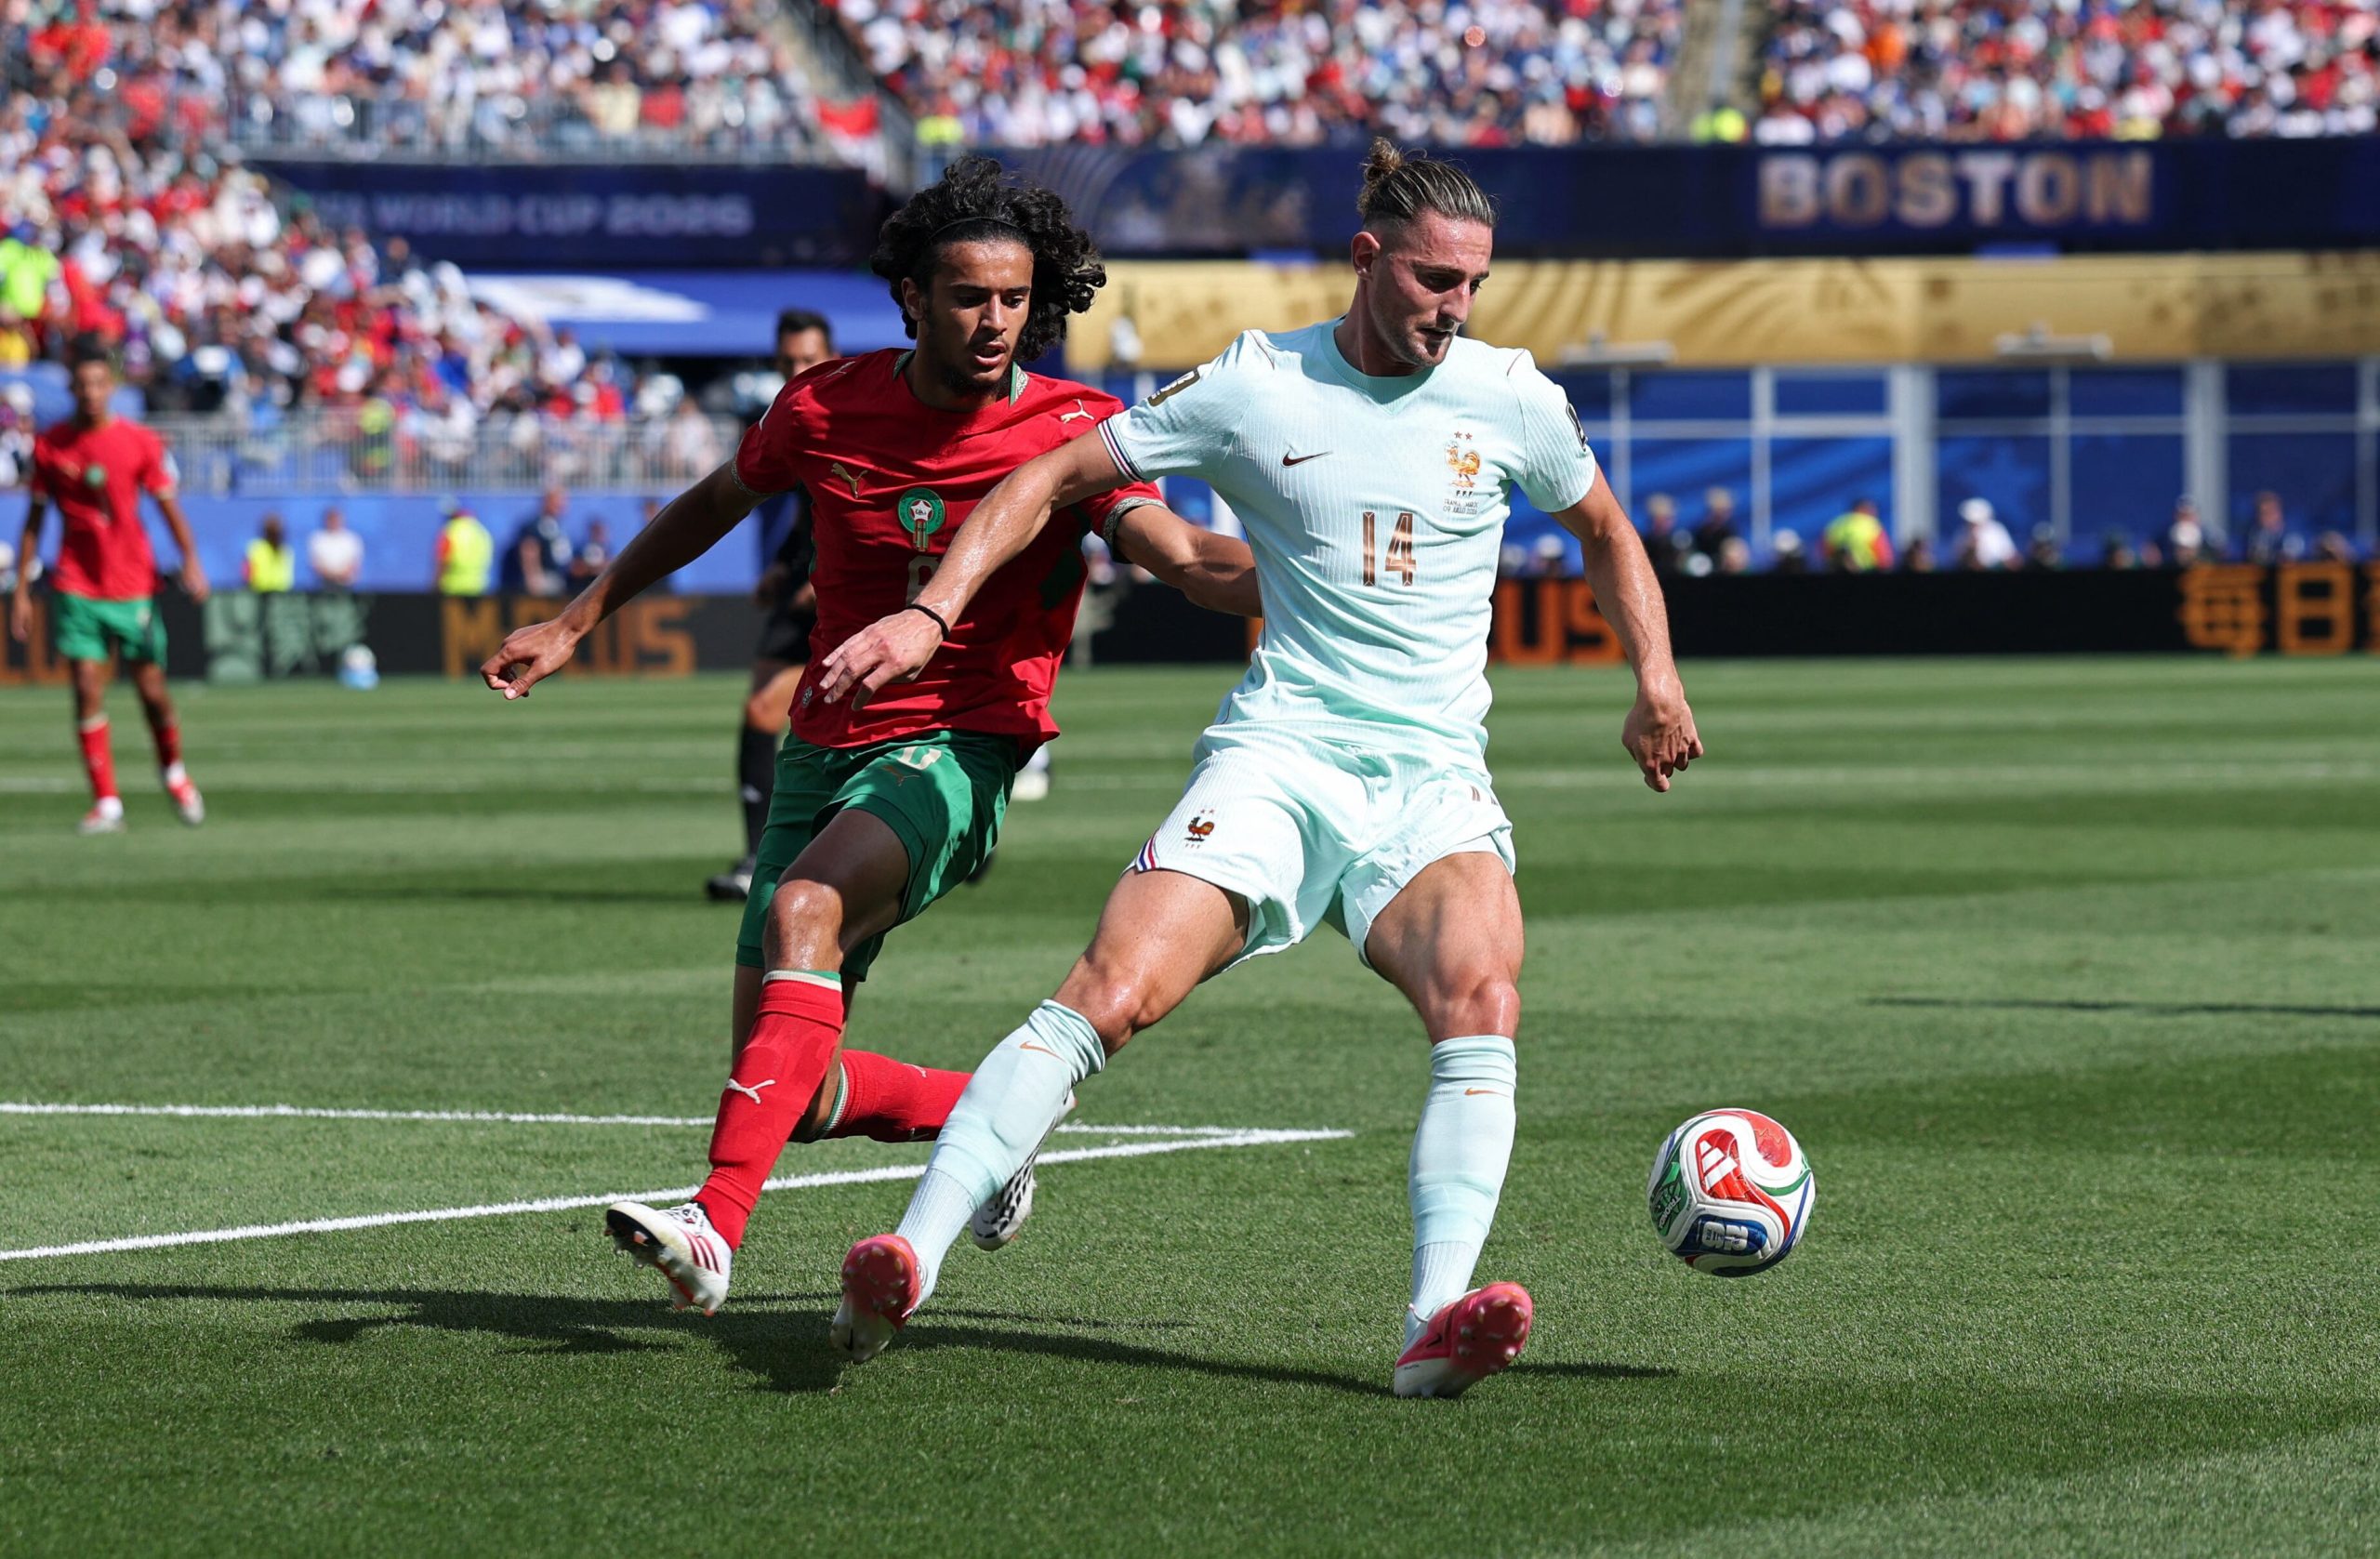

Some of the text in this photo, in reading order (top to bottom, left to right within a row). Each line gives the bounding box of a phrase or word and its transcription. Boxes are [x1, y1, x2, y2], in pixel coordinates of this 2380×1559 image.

[1758, 150, 2152, 227] BOSTON
[1362, 511, 1417, 587] 14
[2175, 561, 2380, 659] 每日
